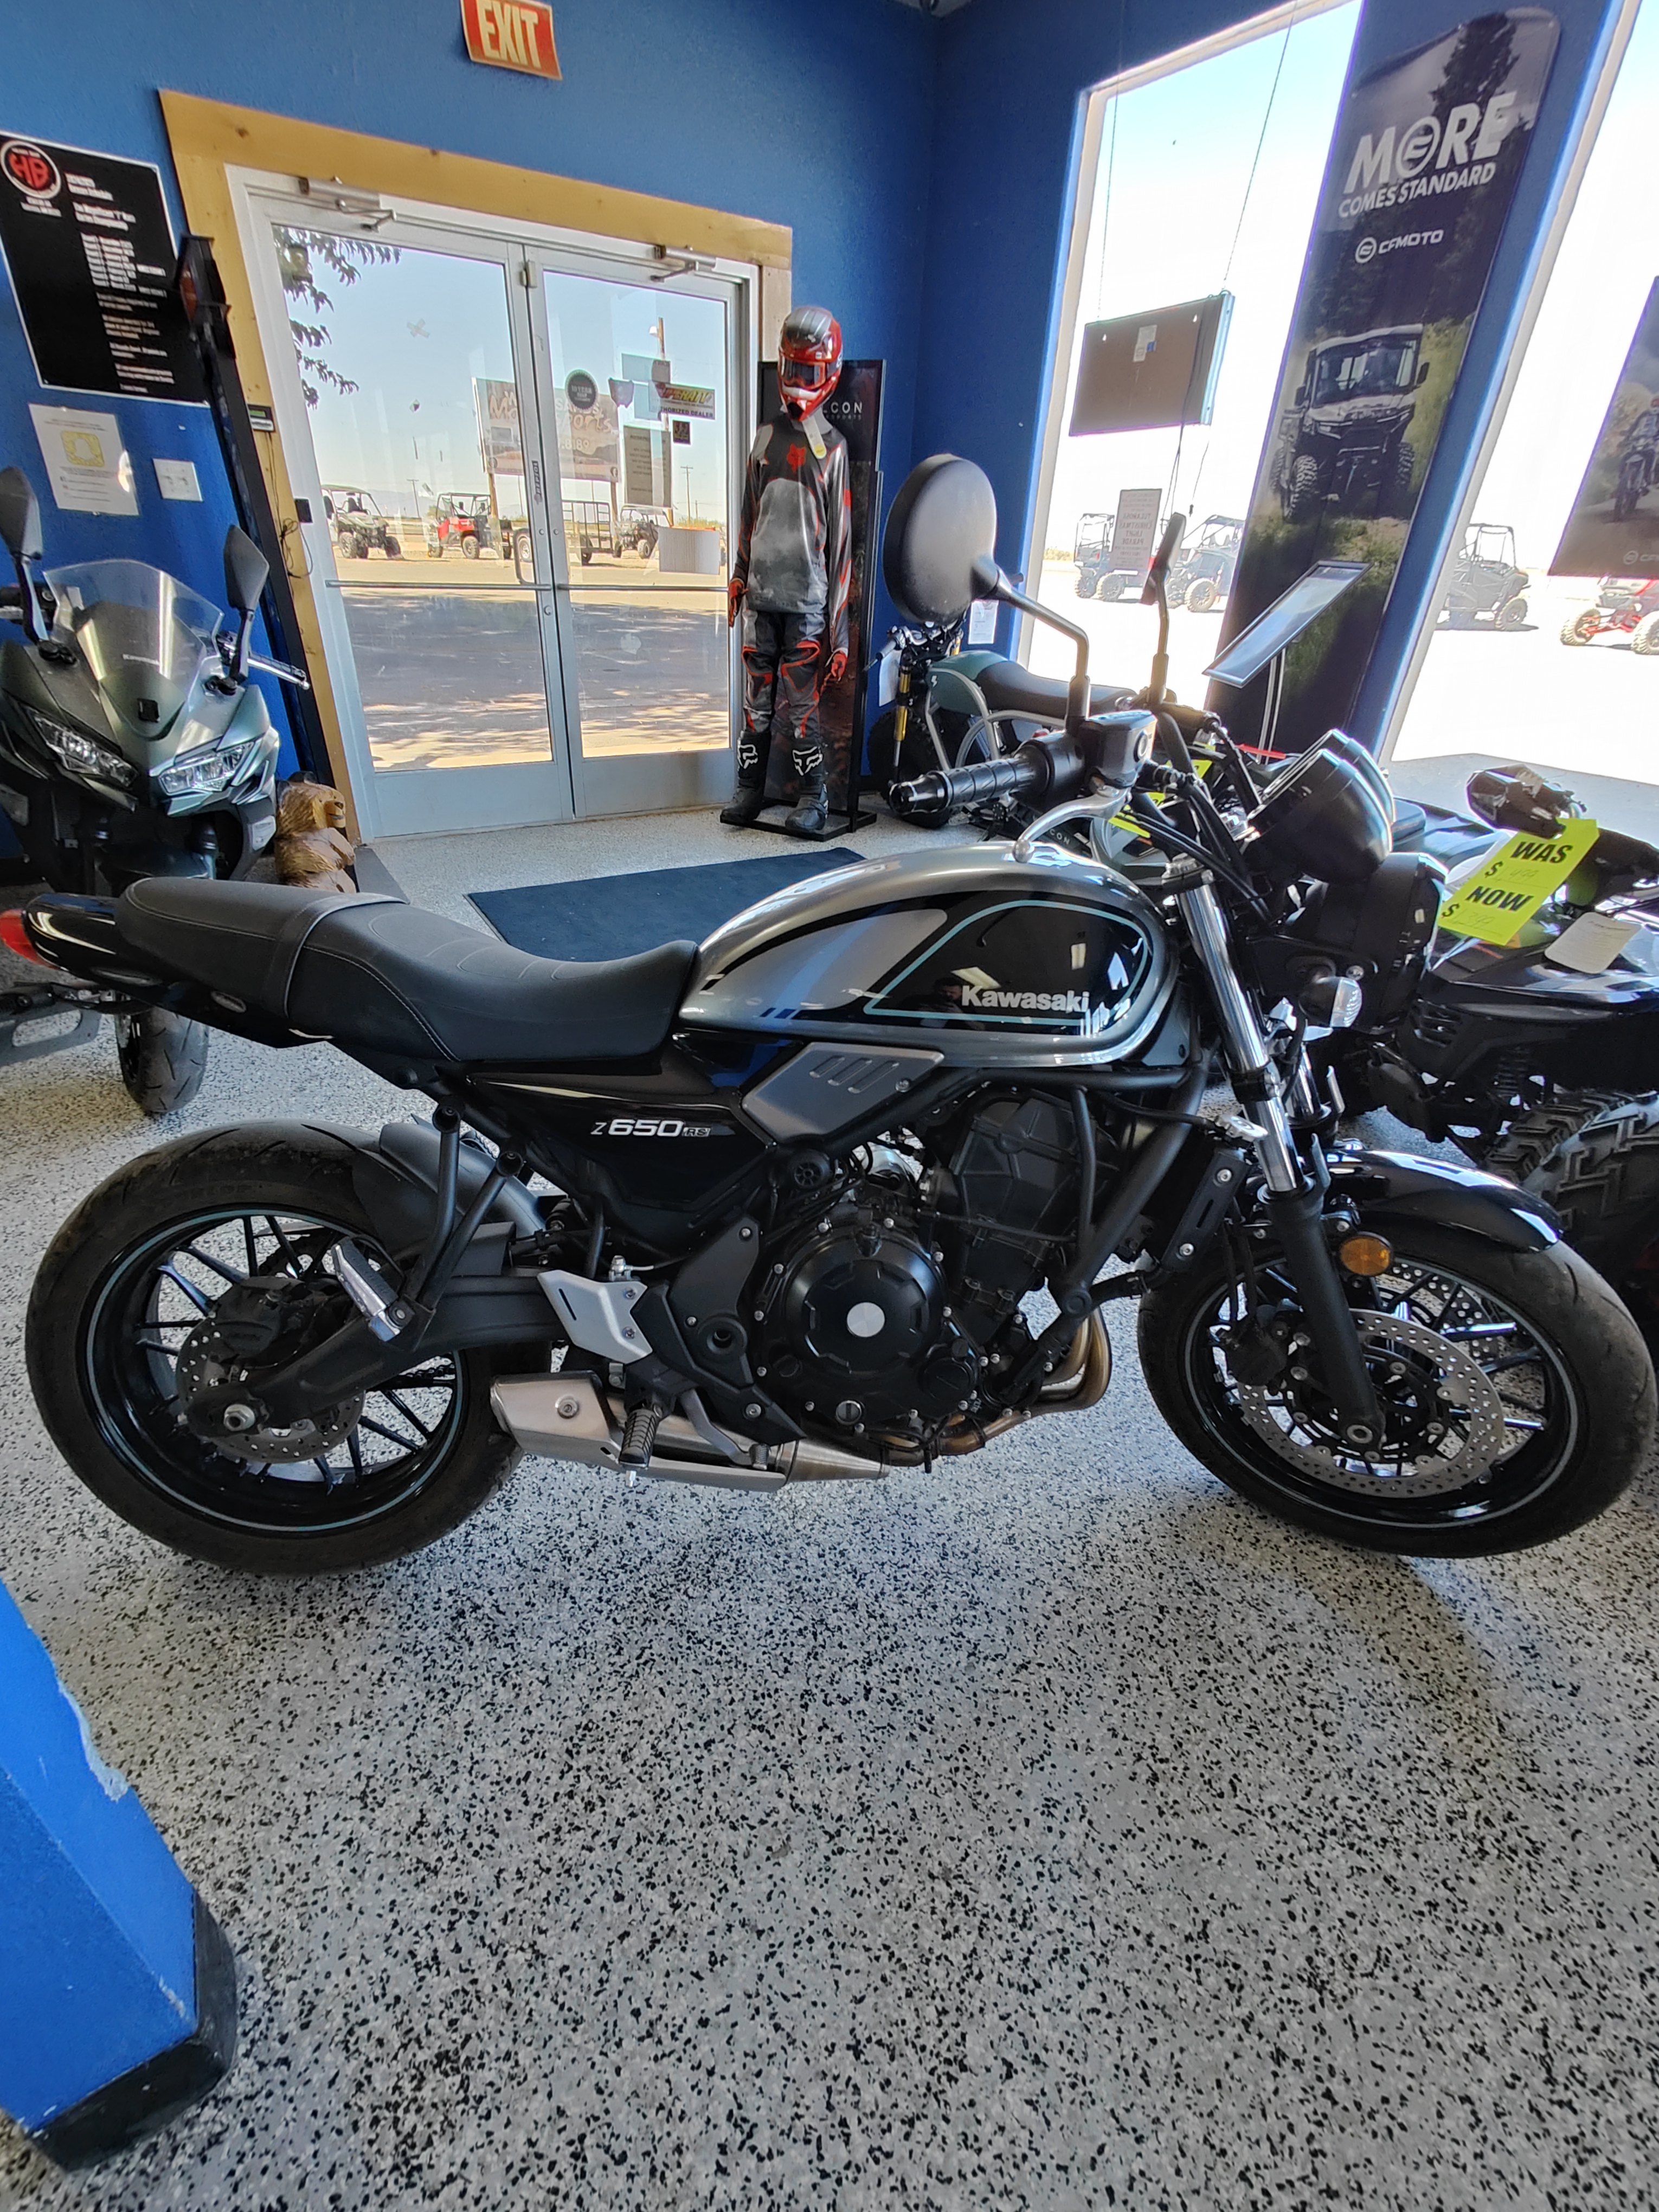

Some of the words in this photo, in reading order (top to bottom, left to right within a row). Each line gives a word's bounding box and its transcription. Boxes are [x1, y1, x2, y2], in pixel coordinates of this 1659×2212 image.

[477, 0, 542, 69] EXIT
[1343, 91, 1517, 194] MORE
[1339, 187, 1397, 217] COMES
[1398, 162, 1496, 204] STANDARD
[1378, 229, 1444, 254] CFMOTO
[1509, 840, 1573, 864] WAS
[1484, 860, 1503, 879] $
[1441, 903, 1460, 919] $
[1464, 885, 1535, 912] NOW
[961, 985, 1090, 1013] Kawasaki
